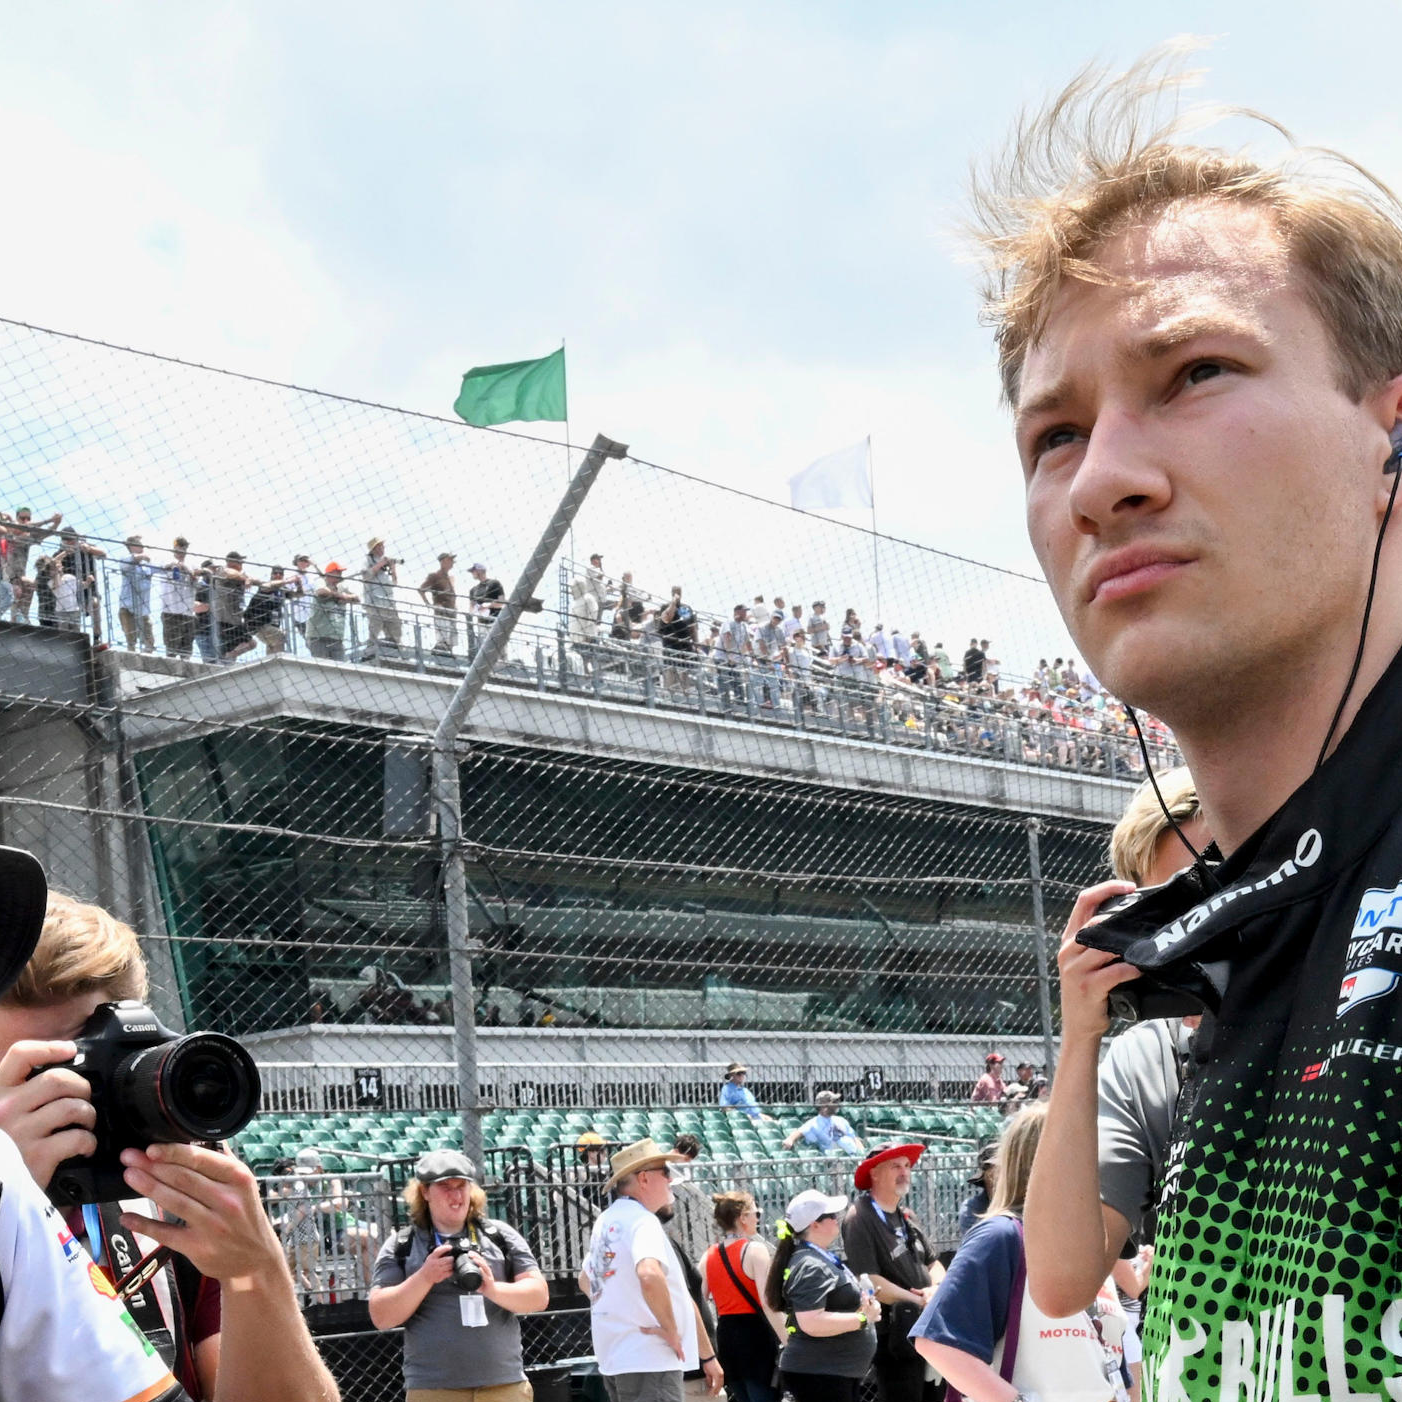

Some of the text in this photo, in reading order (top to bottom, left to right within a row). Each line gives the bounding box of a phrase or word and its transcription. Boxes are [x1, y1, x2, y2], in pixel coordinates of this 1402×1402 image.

[123, 1023, 157, 1033] Canon
[359, 1076, 378, 1098] 14
[869, 1072, 882, 1090] 13
[111, 1233, 146, 1308] Cann
[1039, 1328, 1087, 1339] MOTOR
